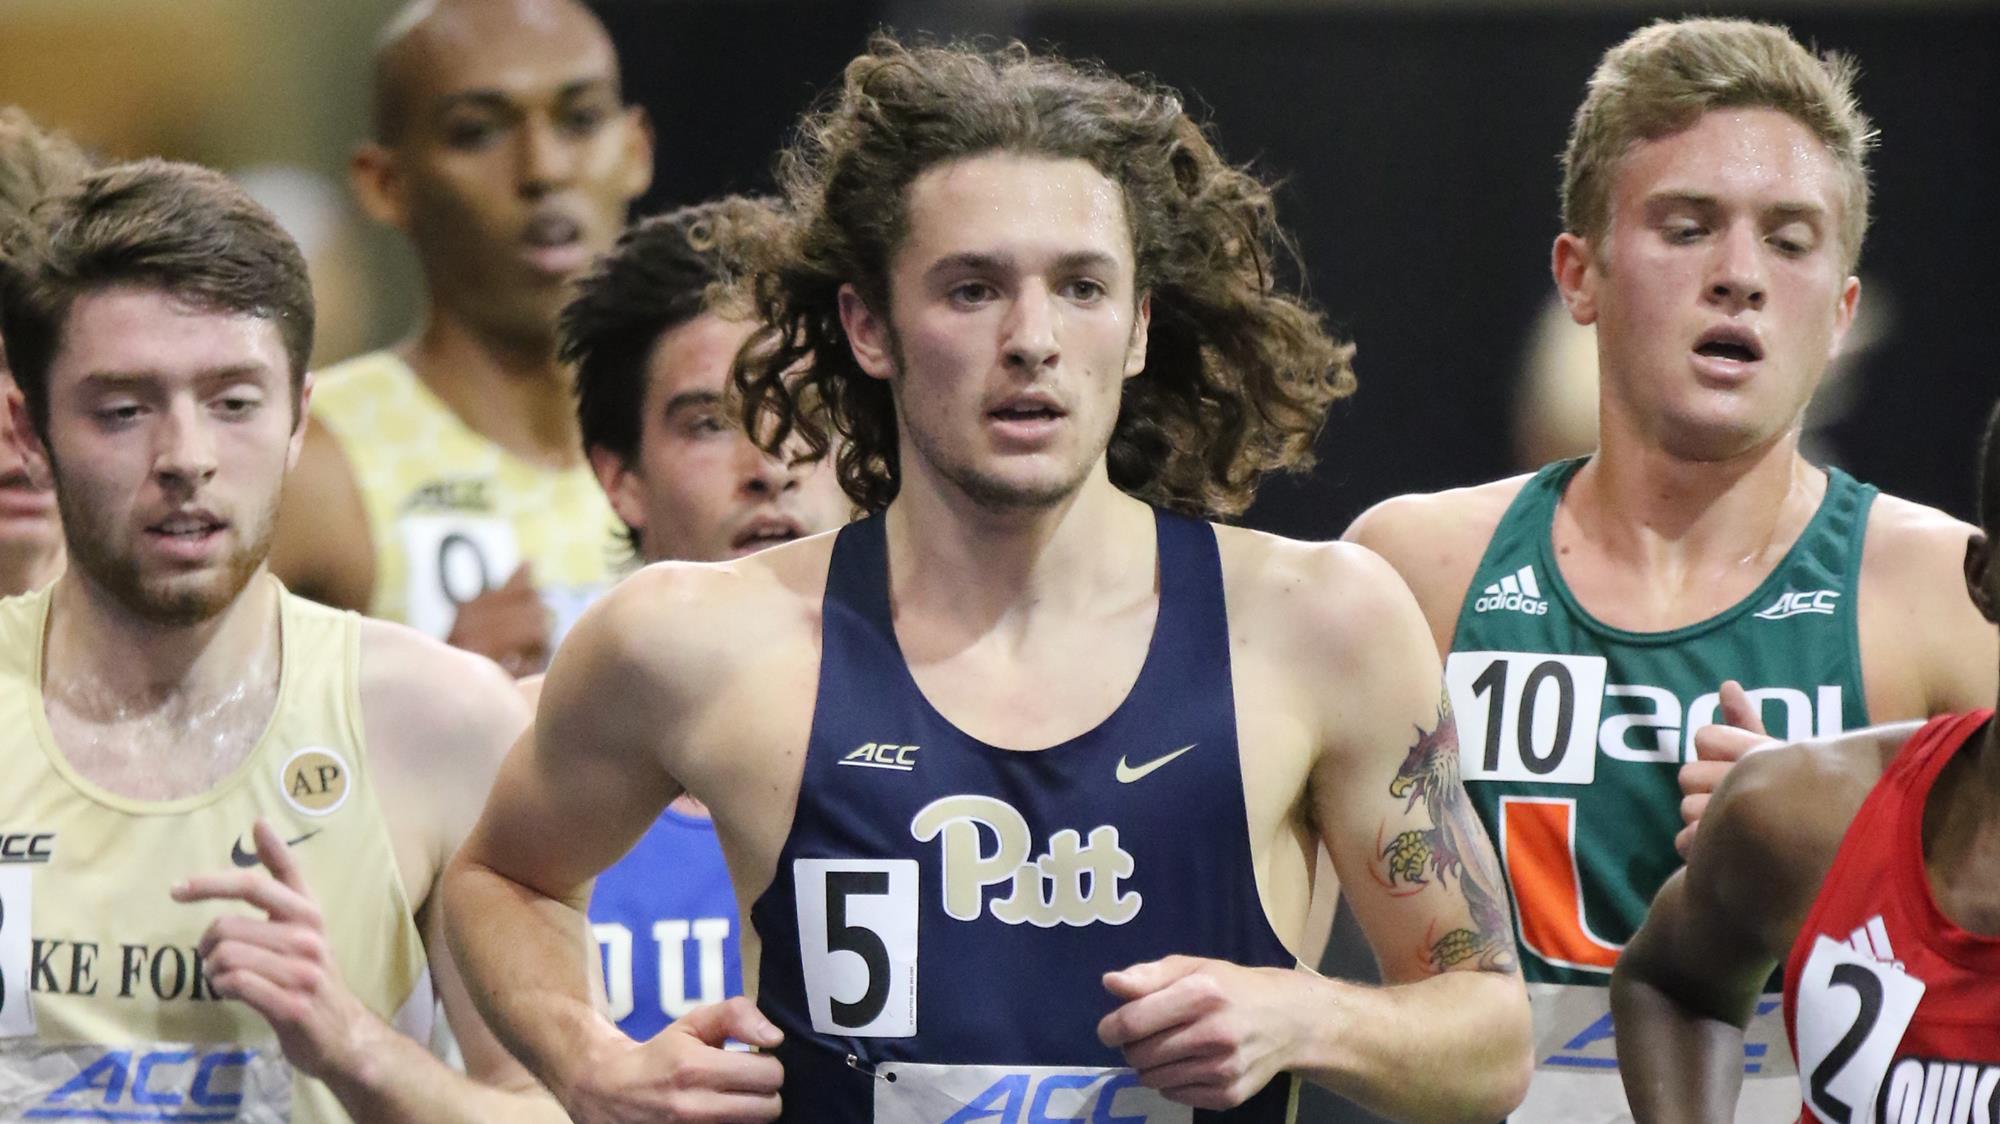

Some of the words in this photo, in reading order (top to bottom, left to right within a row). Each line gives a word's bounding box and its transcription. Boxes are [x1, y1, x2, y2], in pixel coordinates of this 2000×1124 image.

[1475, 592, 1548, 615] adidas
[1762, 590, 1841, 614] ACC
[1471, 658, 1576, 776] 10
[845, 742, 921, 766] ACC
[291, 765, 339, 797] AP
[0, 833, 56, 857] CC
[911, 794, 1142, 928] Pitt
[825, 871, 891, 1029] 5
[1810, 963, 1885, 1124] 2
[44, 1050, 259, 1105] ACC
[942, 1074, 1147, 1124] ACC
